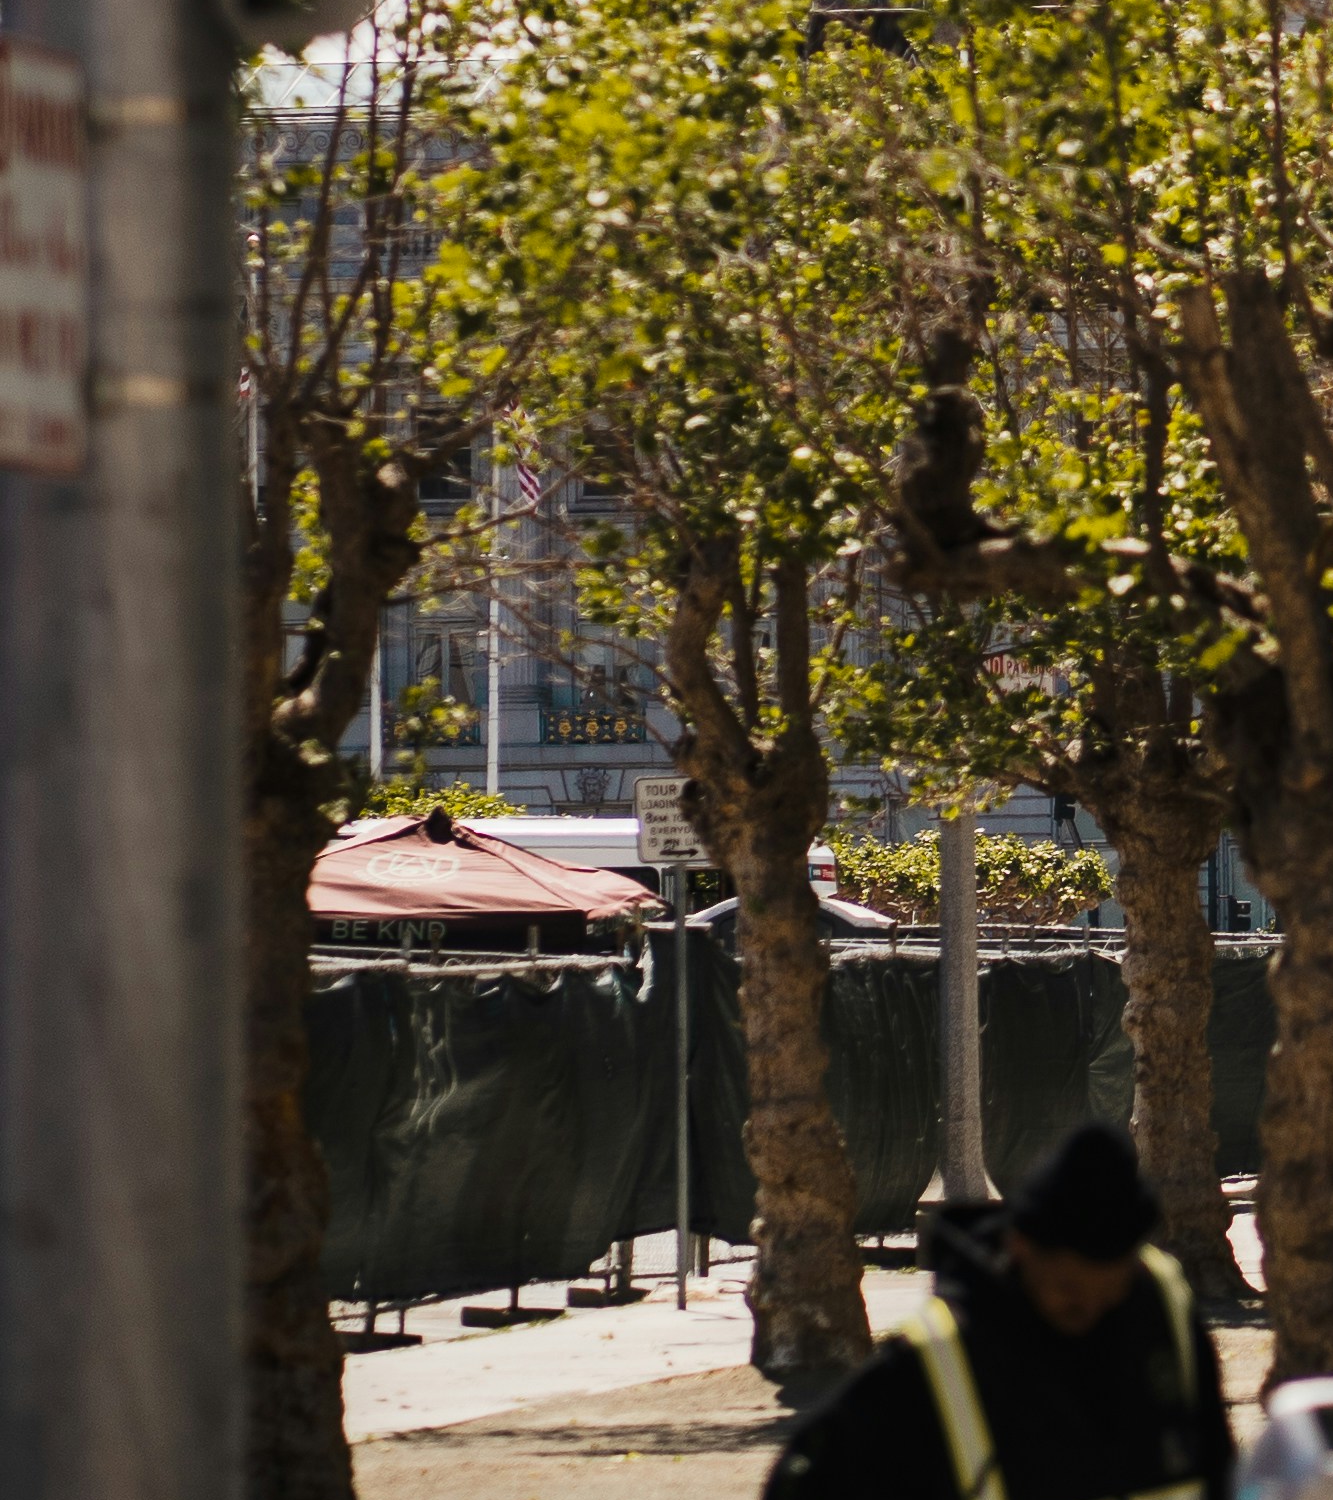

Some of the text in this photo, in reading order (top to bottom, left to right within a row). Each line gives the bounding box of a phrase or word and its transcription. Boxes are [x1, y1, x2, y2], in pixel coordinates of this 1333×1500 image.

[645, 784, 677, 796] TOUR
[331, 919, 446, 941] BE KIND
